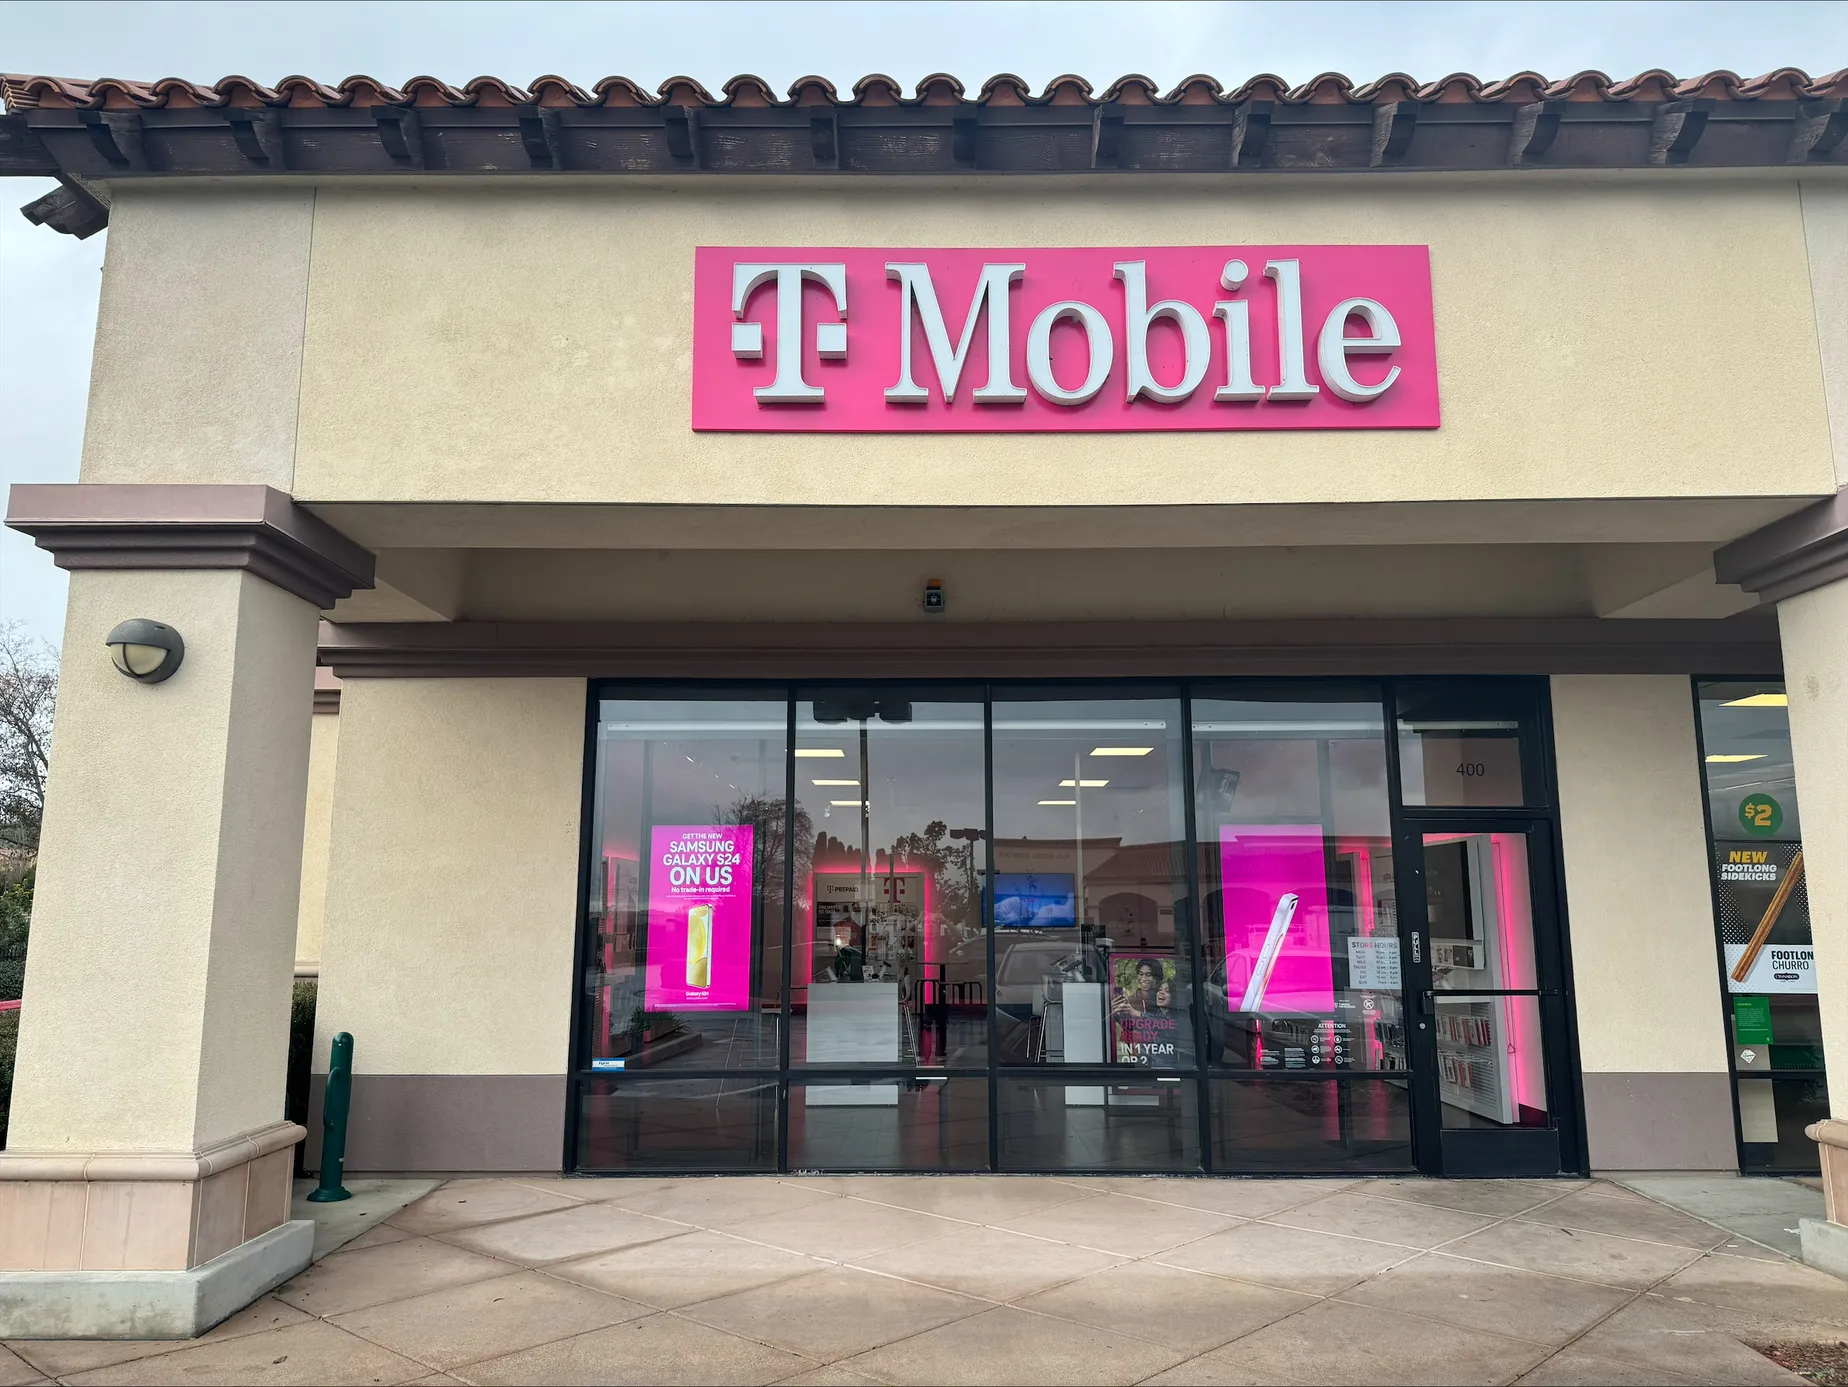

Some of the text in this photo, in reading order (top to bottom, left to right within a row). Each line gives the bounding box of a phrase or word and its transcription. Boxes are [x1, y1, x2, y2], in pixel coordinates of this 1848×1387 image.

[731, 258, 1402, 406] T Mobile
[1456, 763, 1485, 776] 400
[1744, 802, 1772, 826] $2
[669, 840, 735, 853] SAMSUNG
[662, 853, 741, 866] GALAXY S24
[1728, 851, 1768, 864] NEW
[1721, 864, 1777, 872] FOOTLONG
[669, 866, 733, 886] ON US
[1720, 872, 1777, 881] SIDEKICKS
[1771, 950, 1814, 960] FOOTLON
[1772, 960, 1810, 970] CHURRO
[1121, 1019, 1176, 1030] UPGRADE
[1121, 1031, 1158, 1042] READY
[1121, 1044, 1174, 1054] IN 1 YEAR
